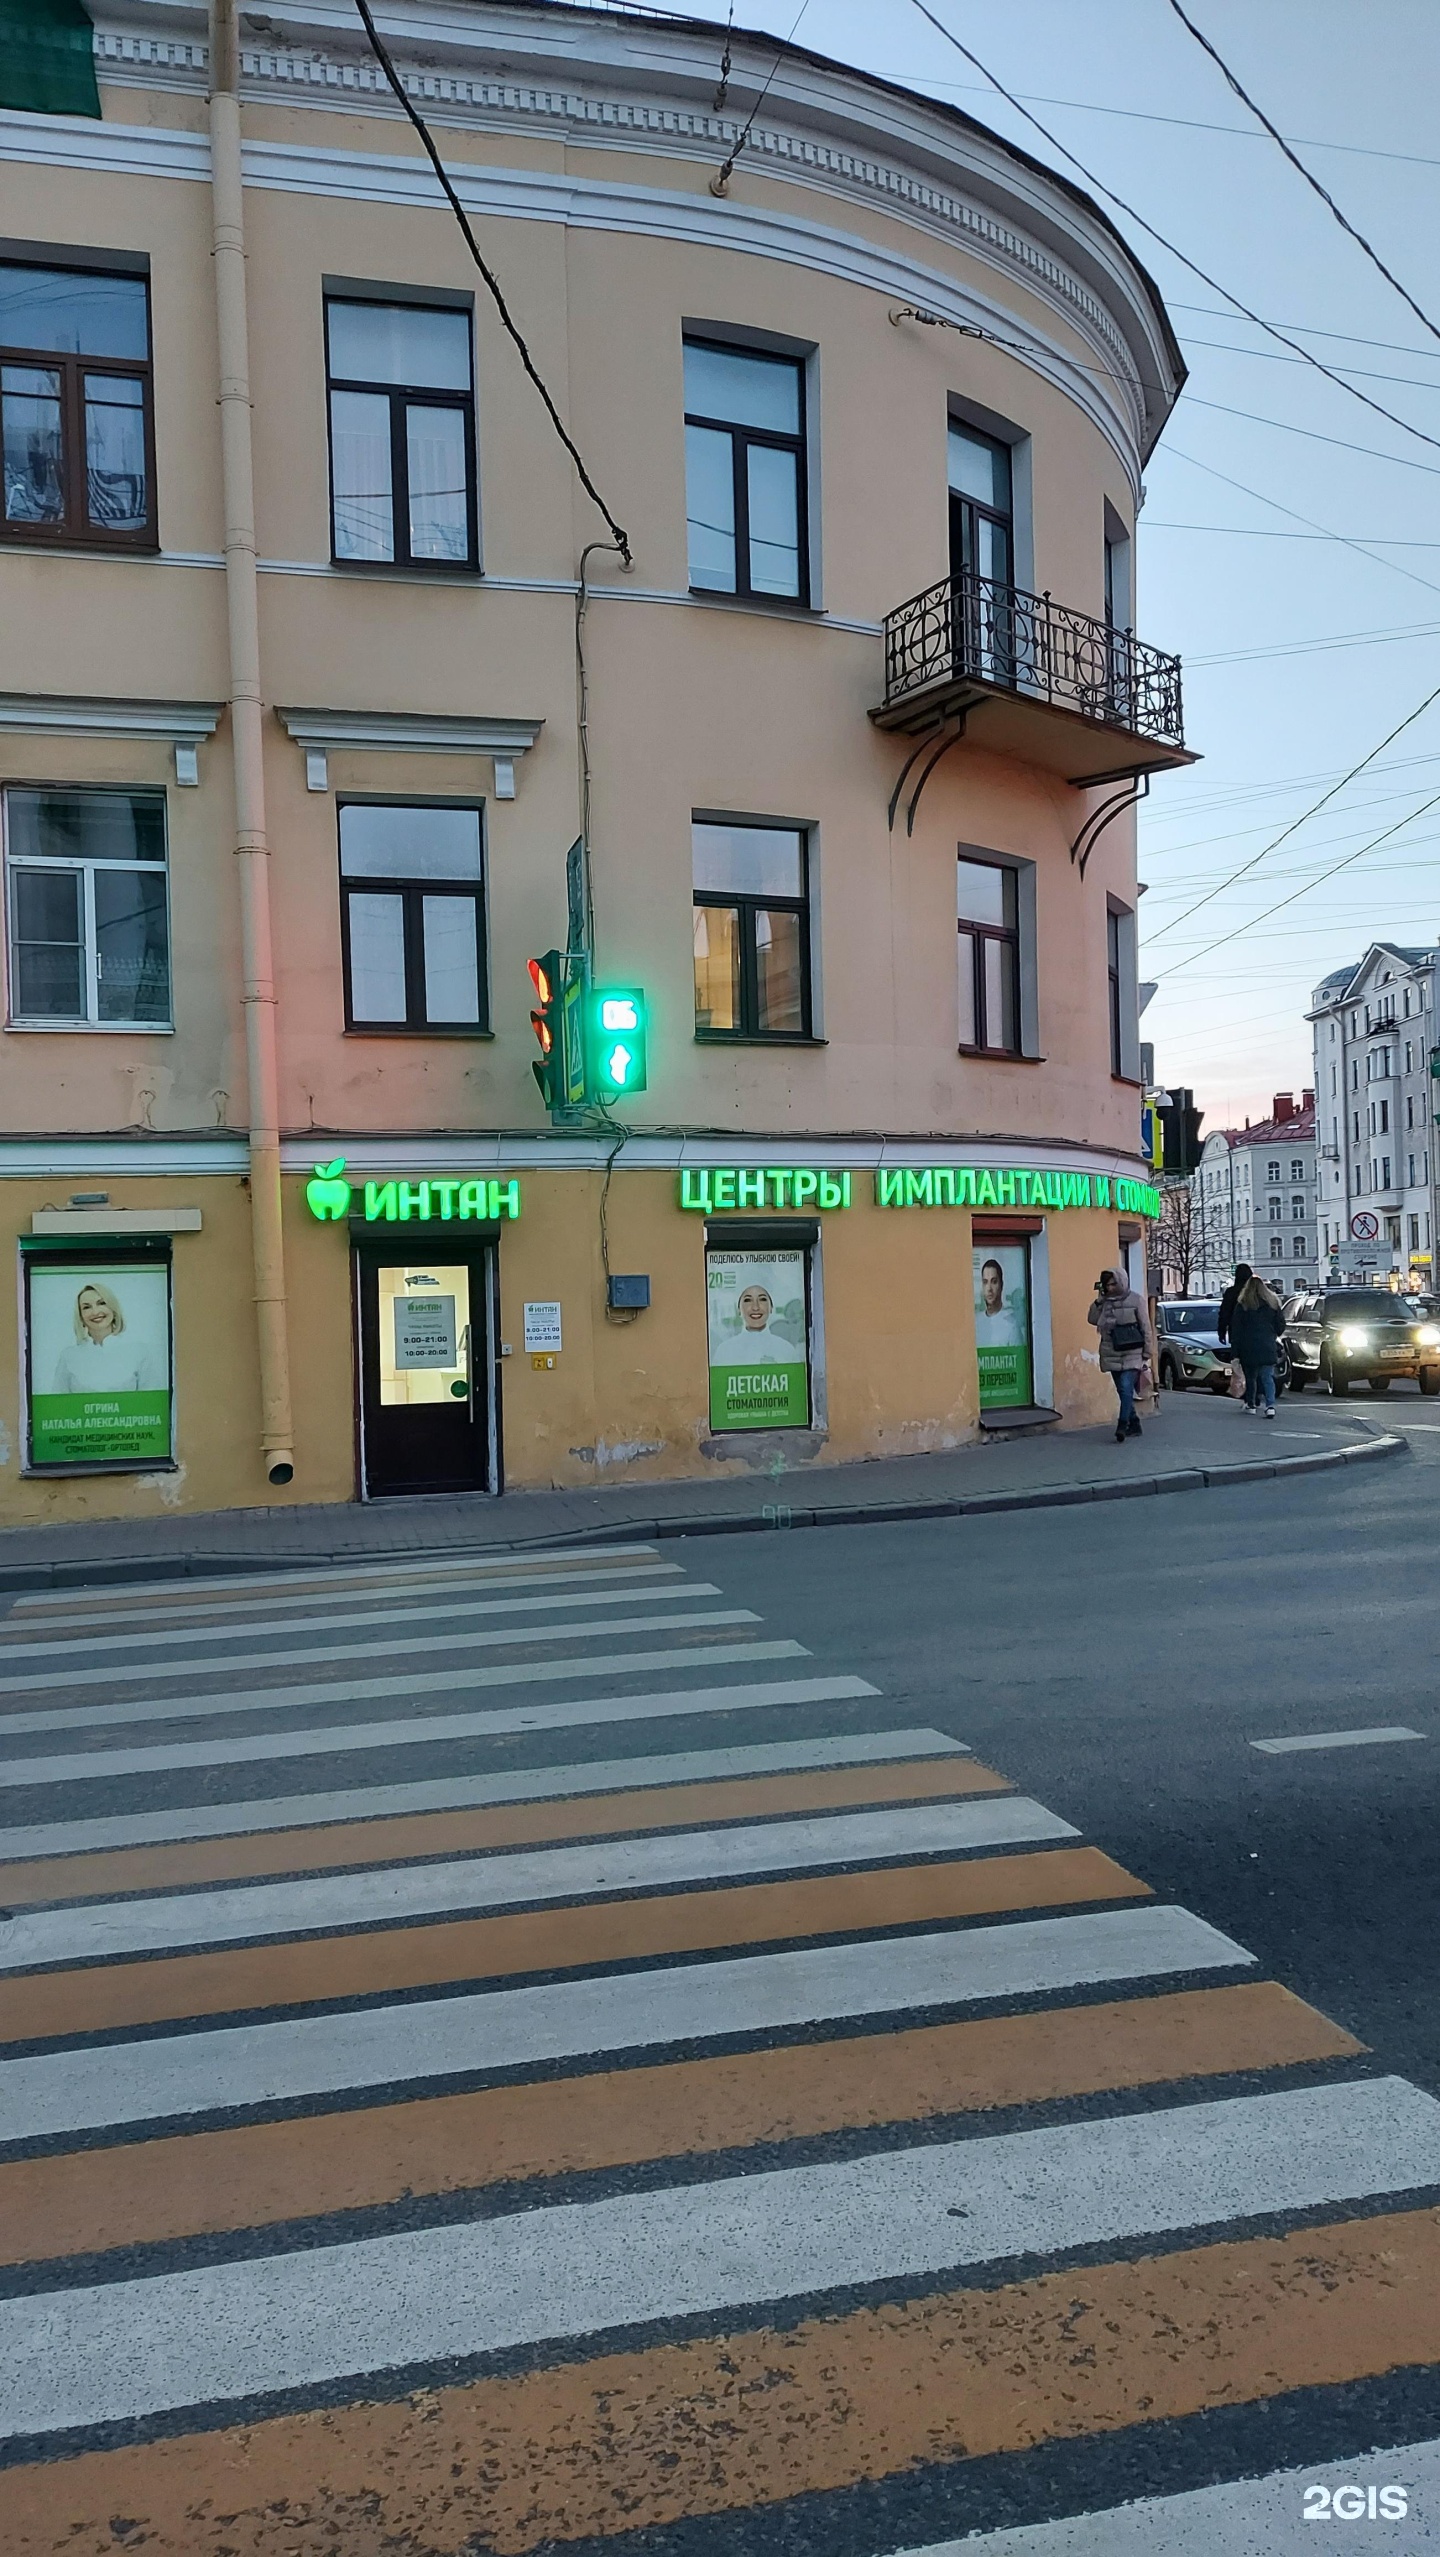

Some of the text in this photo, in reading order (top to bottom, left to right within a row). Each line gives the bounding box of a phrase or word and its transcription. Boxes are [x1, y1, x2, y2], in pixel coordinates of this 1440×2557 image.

[681, 1168, 851, 1214] ЦЕНТРЫ
[878, 1168, 1091, 1211] ИМПЛАНТАЦИИ
[1095, 1175, 1111, 1208] И
[363, 1178, 521, 1222] ИНТАН
[709, 1252, 800, 1265] ПОДЕЛЮСЬ УЛЫБКОЮ СВОЕЙ!
[708, 1272, 723, 1289] 20
[415, 1303, 442, 1312] ИНТАН
[403, 1335, 448, 1344] 9:00-21:00
[726, 1373, 789, 1398] ДЕТСКАЯ
[84, 1402, 120, 1415] ОГРИНА
[726, 1396, 789, 1410] СТОМАТОЛОГИЯ
[41, 1414, 162, 1431] НАТАЛЬЯ АЛЕКСАНДРОВНА
[48, 1434, 84, 1444] КАНДИДАТ
[85, 1431, 135, 1442] МЕДИЦИНСКИХ
